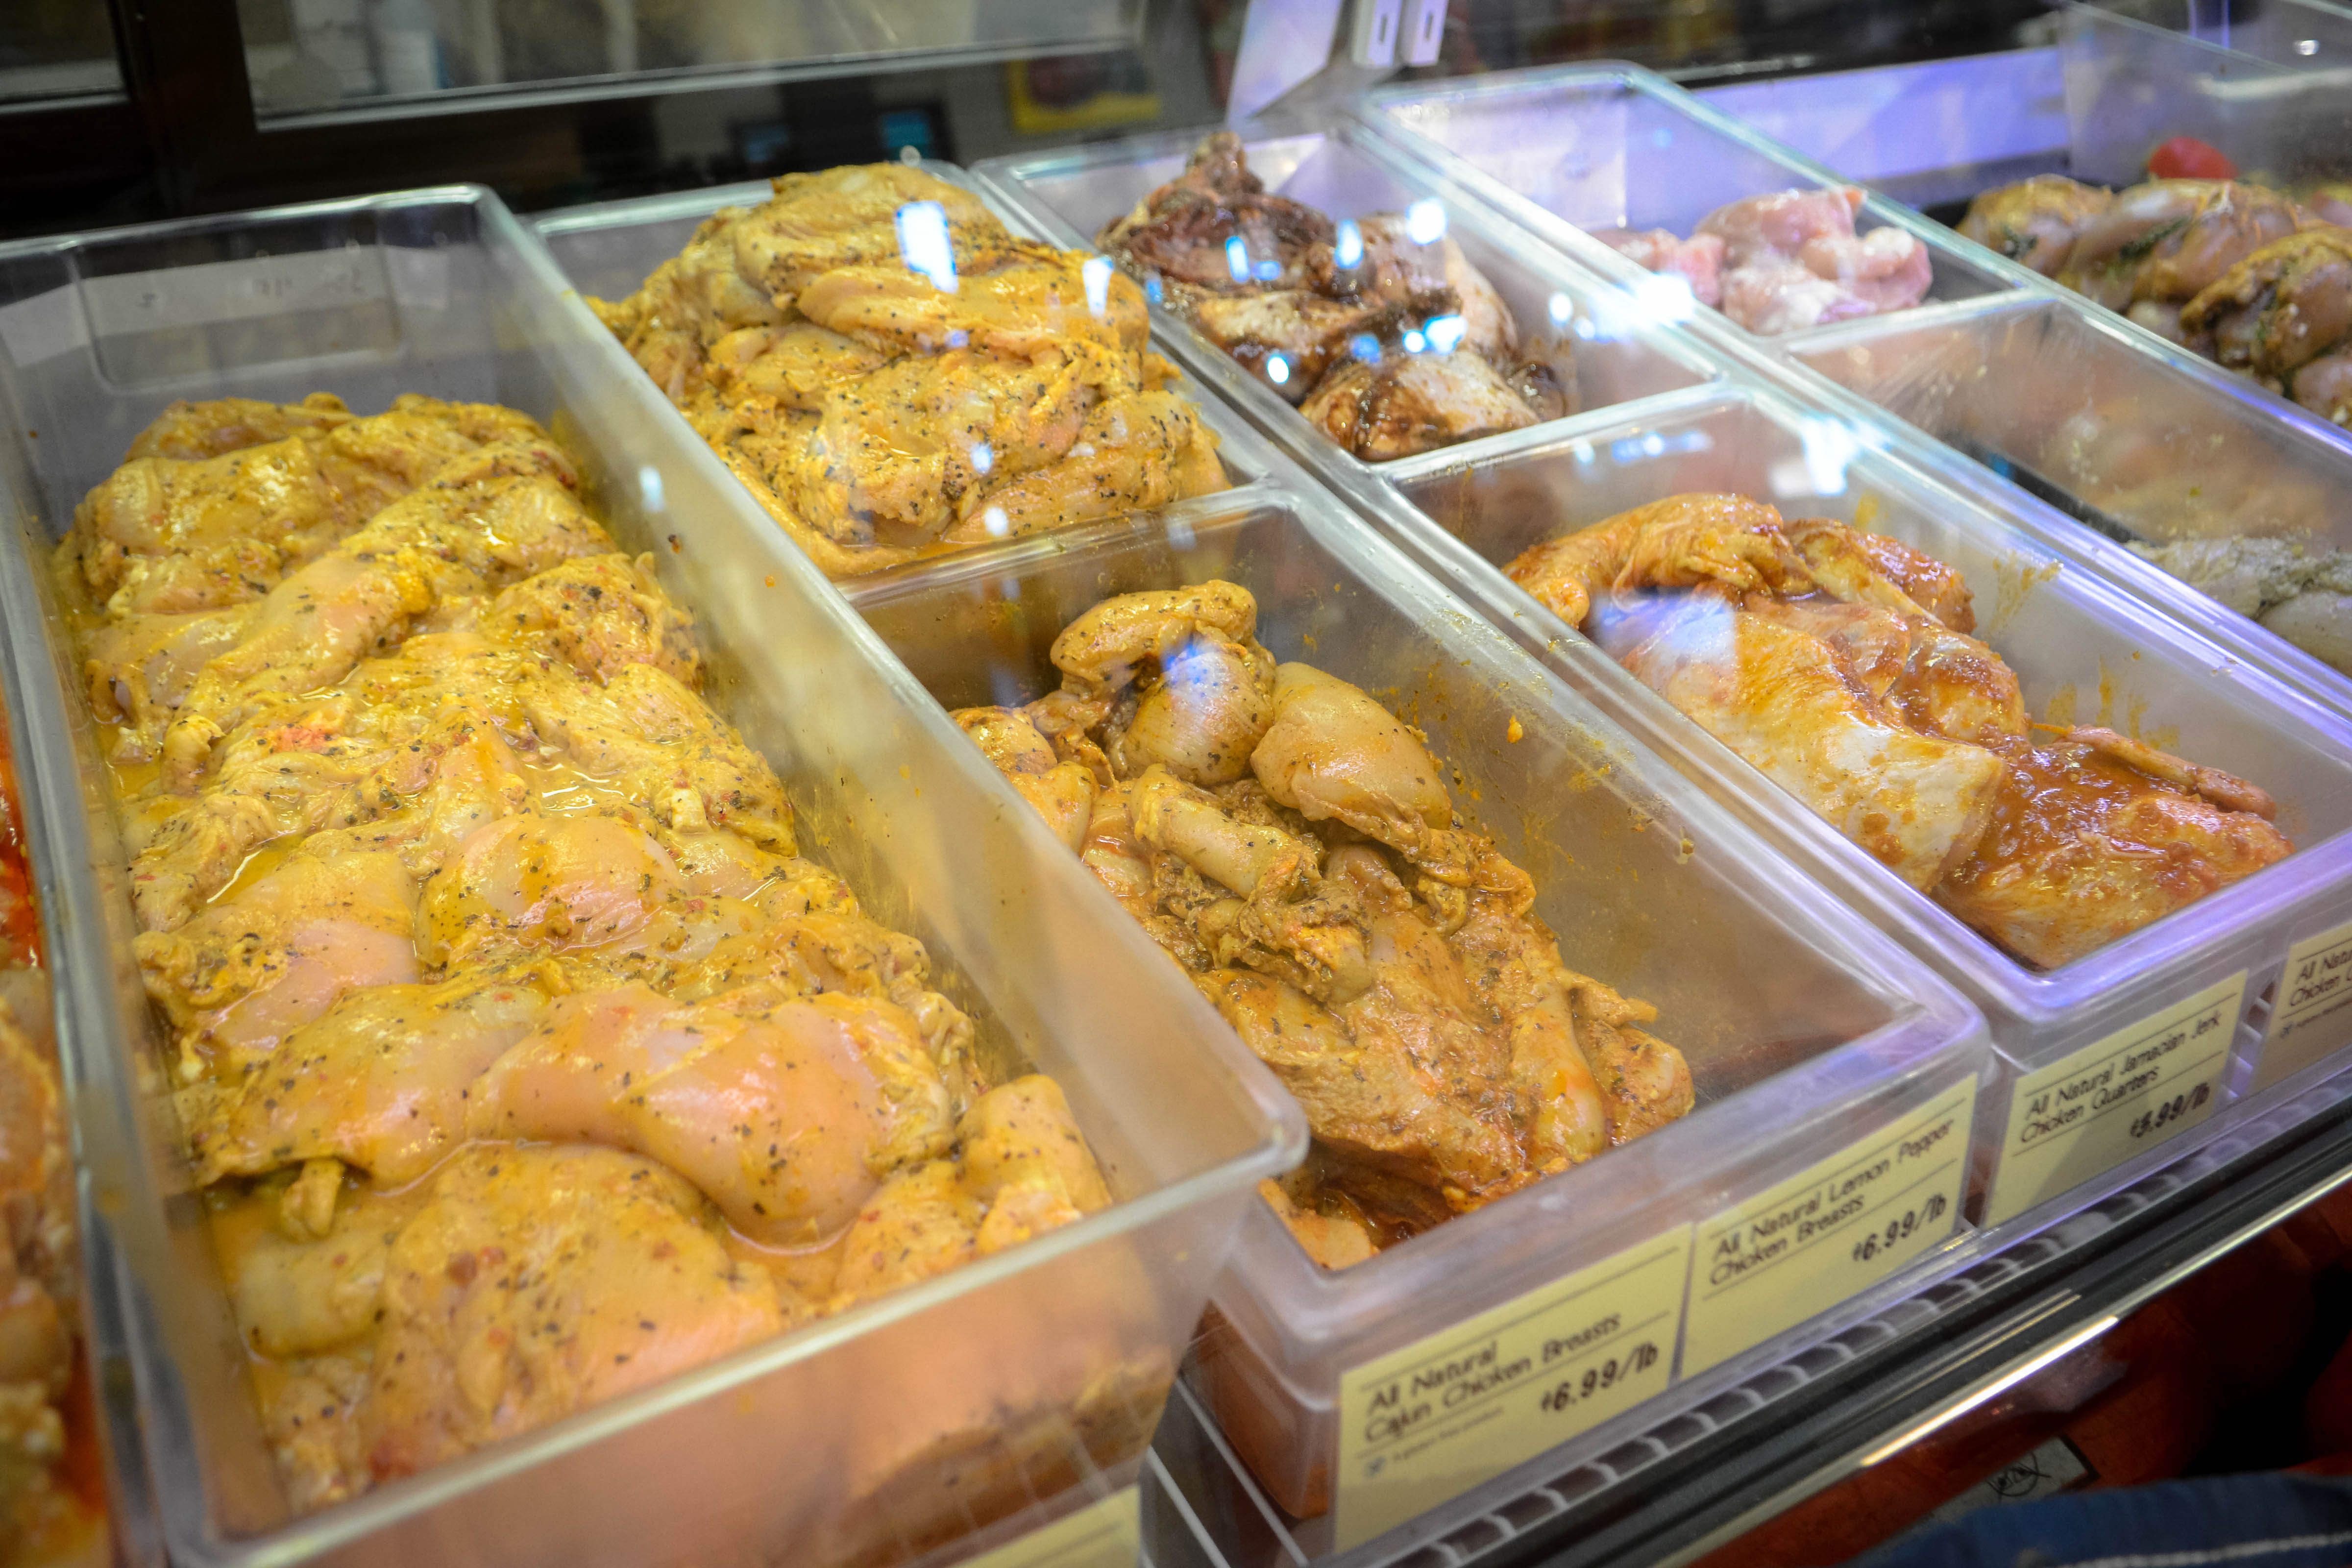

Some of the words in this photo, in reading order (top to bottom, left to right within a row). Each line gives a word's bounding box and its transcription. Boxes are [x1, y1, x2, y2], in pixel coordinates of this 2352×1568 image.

[2289, 976, 2340, 1006] Chicken
[2024, 1093, 2050, 1121] All
[2055, 1062, 2115, 1107] Natural
[2119, 1032, 2185, 1076] Jamaican
[2191, 1010, 2222, 1039] Jerk
[2021, 1105, 2084, 1143] Chicken
[2092, 1066, 2160, 1109] Quarters
[1712, 1232, 1741, 1263] All
[1750, 1191, 1821, 1244] Natural
[1829, 1159, 1890, 1203] Lemon
[1897, 1119, 1954, 1164] Pepper
[1853, 1193, 1947, 1262] $6.99/lb
[1710, 1238, 1788, 1285] Chicken
[1797, 1195, 1865, 1243] Breasts
[1364, 1403, 1432, 1442] Cajun
[1443, 1357, 1532, 1408] Chicken
[1543, 1313, 1621, 1363] Breasts
[1367, 1383, 1399, 1416] All
[1411, 1340, 1497, 1397] Natural
[1541, 1342, 1659, 1412] $6.99/lb
